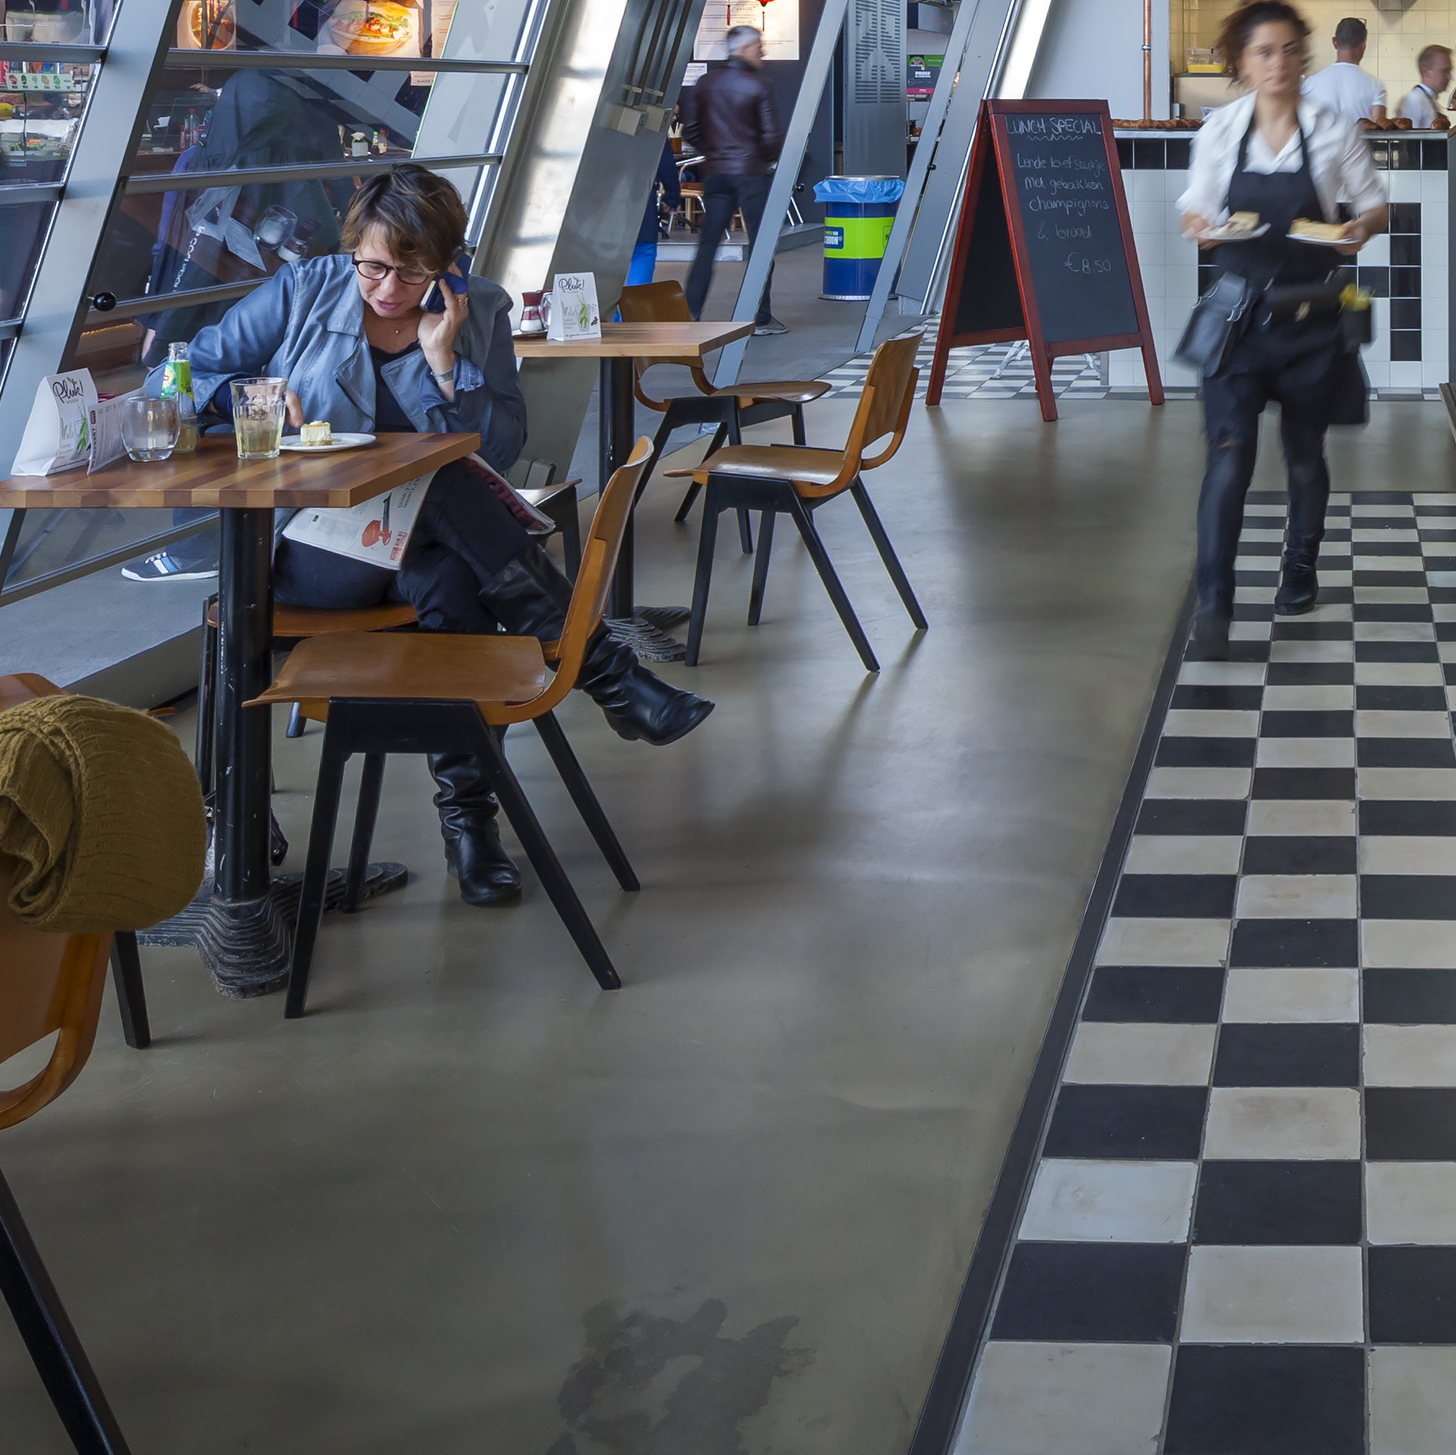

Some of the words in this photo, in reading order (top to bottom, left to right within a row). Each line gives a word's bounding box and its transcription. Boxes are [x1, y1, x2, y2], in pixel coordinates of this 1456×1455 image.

[1005, 116, 1046, 135] LUNCH
[1049, 117, 1102, 135] SPECIAL
[1055, 223, 1092, 239] brood
